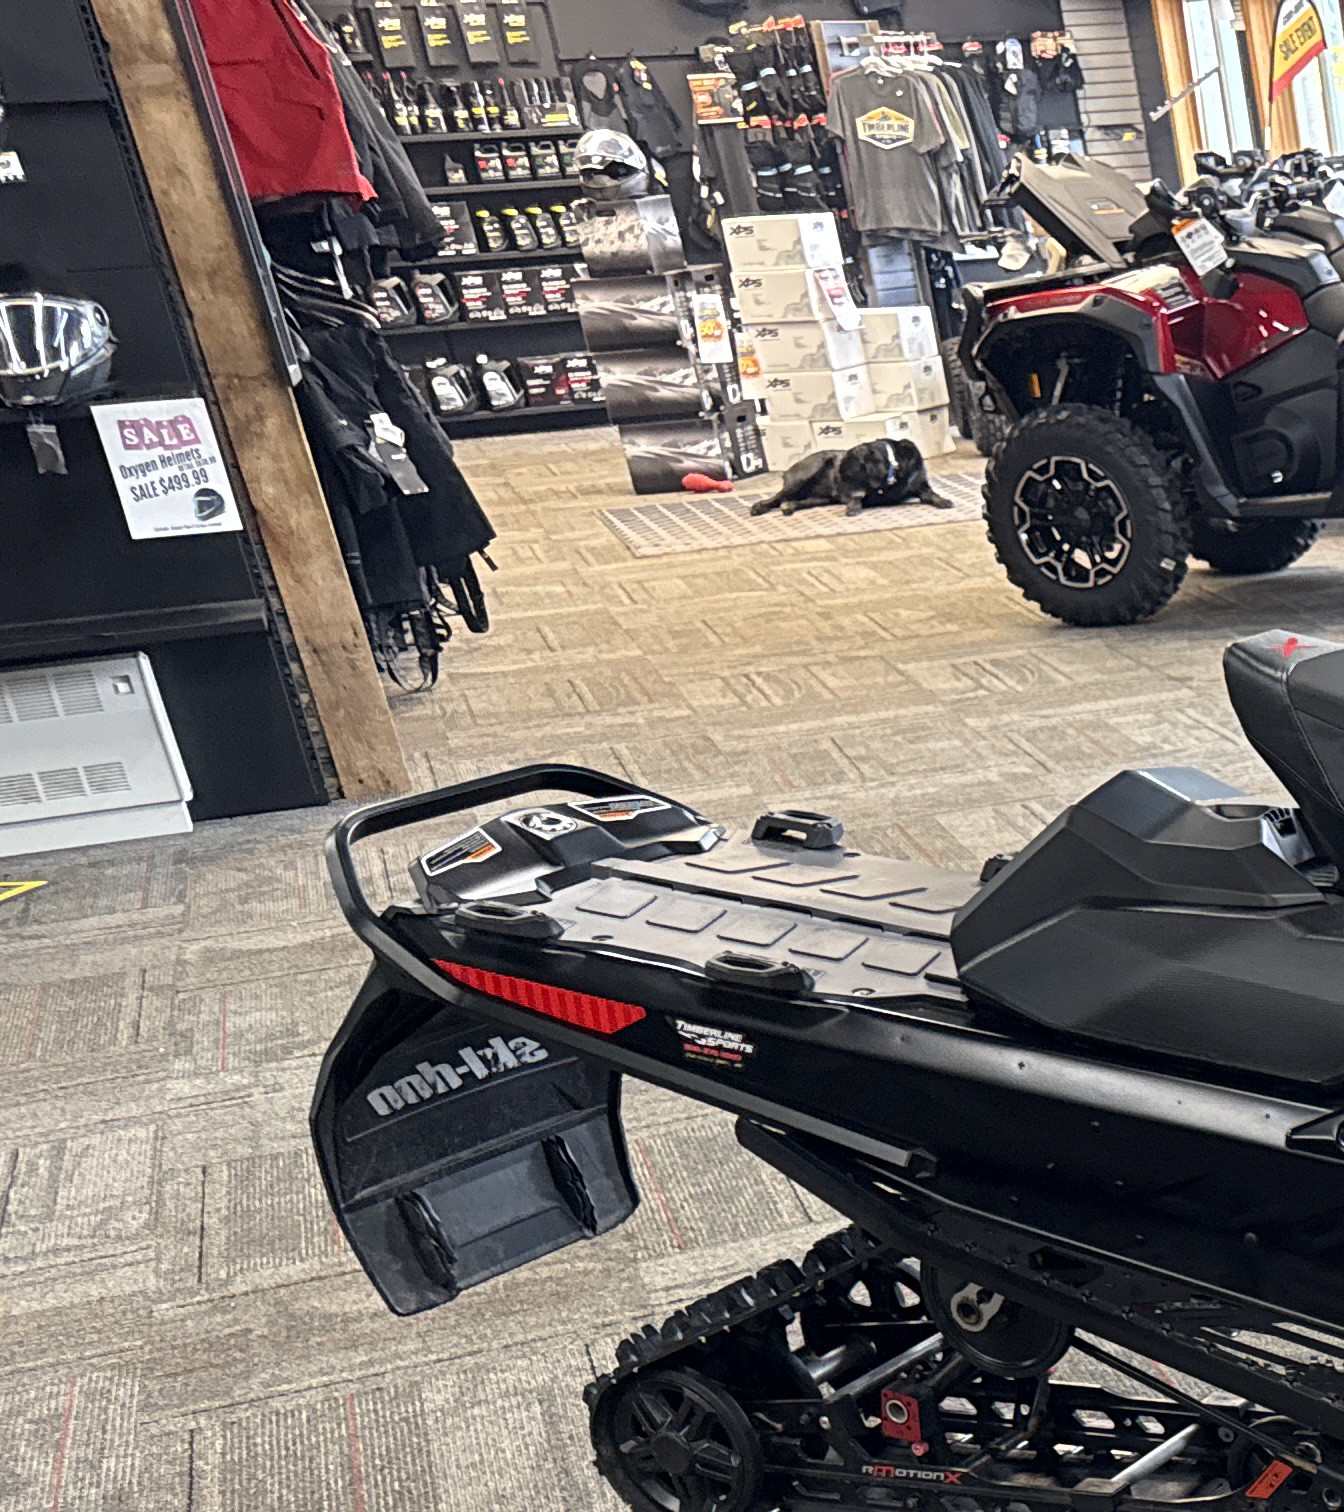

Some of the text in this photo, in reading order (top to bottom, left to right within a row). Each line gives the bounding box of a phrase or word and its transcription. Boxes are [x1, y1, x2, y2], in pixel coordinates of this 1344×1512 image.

[122, 423, 195, 445] SALE
[119, 459, 158, 480] Oxygen
[157, 447, 202, 469] Helmets
[130, 467, 209, 502] SALE $499.99
[676, 1019, 743, 1042] TIMBERLINE
